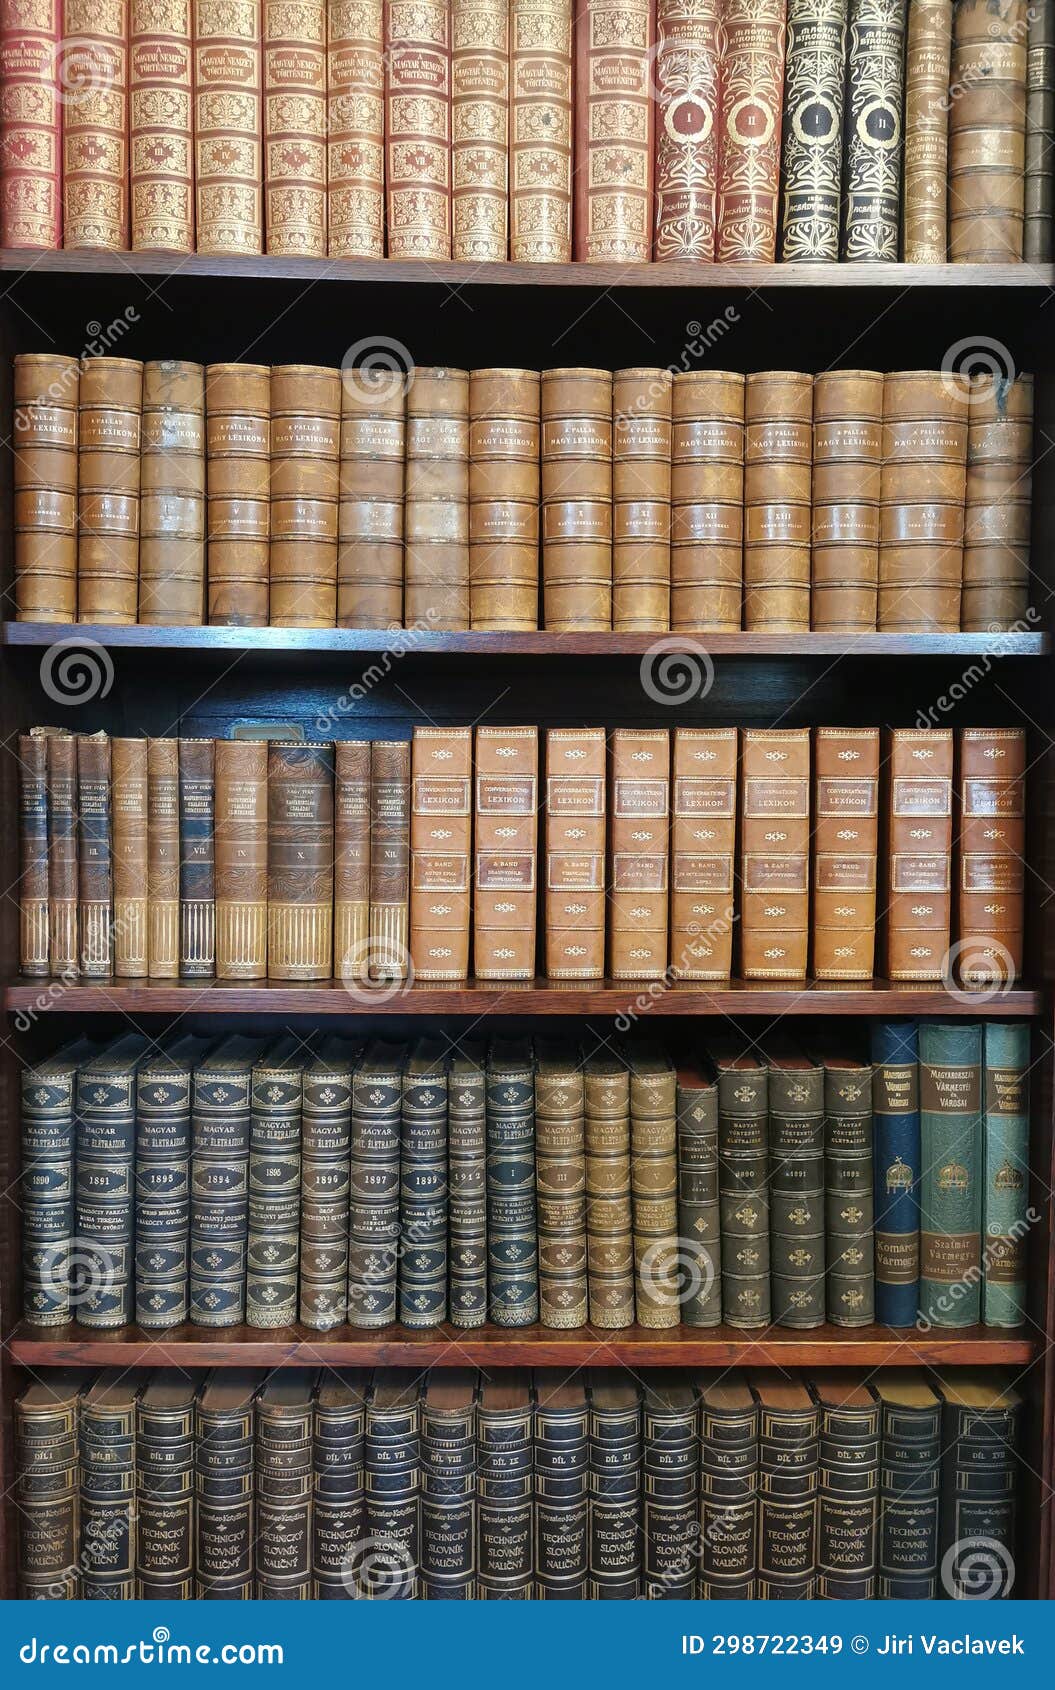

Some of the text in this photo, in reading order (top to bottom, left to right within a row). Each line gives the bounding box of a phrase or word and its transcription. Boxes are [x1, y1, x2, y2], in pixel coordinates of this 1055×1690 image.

[98, 429, 137, 439] LEXIKONA
[940, 1098, 967, 1108] VÁROSAI
[203, 1125, 235, 1134] MAGYAR
[259, 1121, 291, 1129] MAGYAR
[28, 1127, 60, 1135] MAGYAR
[85, 1127, 115, 1135] MAGYAR
[144, 1126, 176, 1134] MAGYAR
[361, 1128, 392, 1136] MAGYAR
[411, 1128, 441, 1136] MAGYAR
[452, 1127, 481, 1135] MAGYAR
[89, 1176, 110, 1185] 1891
[208, 1175, 230, 1183] 1894
[316, 1175, 338, 1184] 1896
[365, 1176, 387, 1184] 1897
[416, 1176, 437, 1185] 1899
[455, 1173, 481, 1181] 1912
[34, 1451, 48, 1460] DÍL
[151, 1452, 175, 1461] DÍL III
[326, 1453, 352, 1461] DÍL VI
[377, 1451, 406, 1460] DÍL VII
[431, 1454, 444, 1463] DÍL
[605, 1453, 631, 1463] DÍL XI
[659, 1454, 688, 1463] DÍL XII
[717, 1454, 747, 1463] DÍL XIII
[777, 1454, 807, 1463] DÍL XIV
[837, 1450, 851, 1459] DÍL
[895, 1450, 931, 1459] DÍL XVI
[972, 1452, 985, 1460] DÍL
[208, 1455, 235, 1464] DÍL IV
[270, 1455, 283, 1464] DÍL
[492, 1458, 506, 1466] DÍL
[552, 1455, 566, 1464] DÍL
[145, 1541, 181, 1552] SLOVNÍK
[374, 1539, 410, 1551] SLOVNÍK
[428, 1543, 464, 1554] SLOVNÍK
[600, 1540, 635, 1553] SLOVNÍK
[771, 1542, 807, 1553] SLOVNÍK
[829, 1539, 865, 1550] SLOVNÍK
[264, 1545, 298, 1556] SLOVNÍK
[488, 1546, 524, 1558] SLOVNÍK
[547, 1544, 581, 1557] SLOVNÍK
